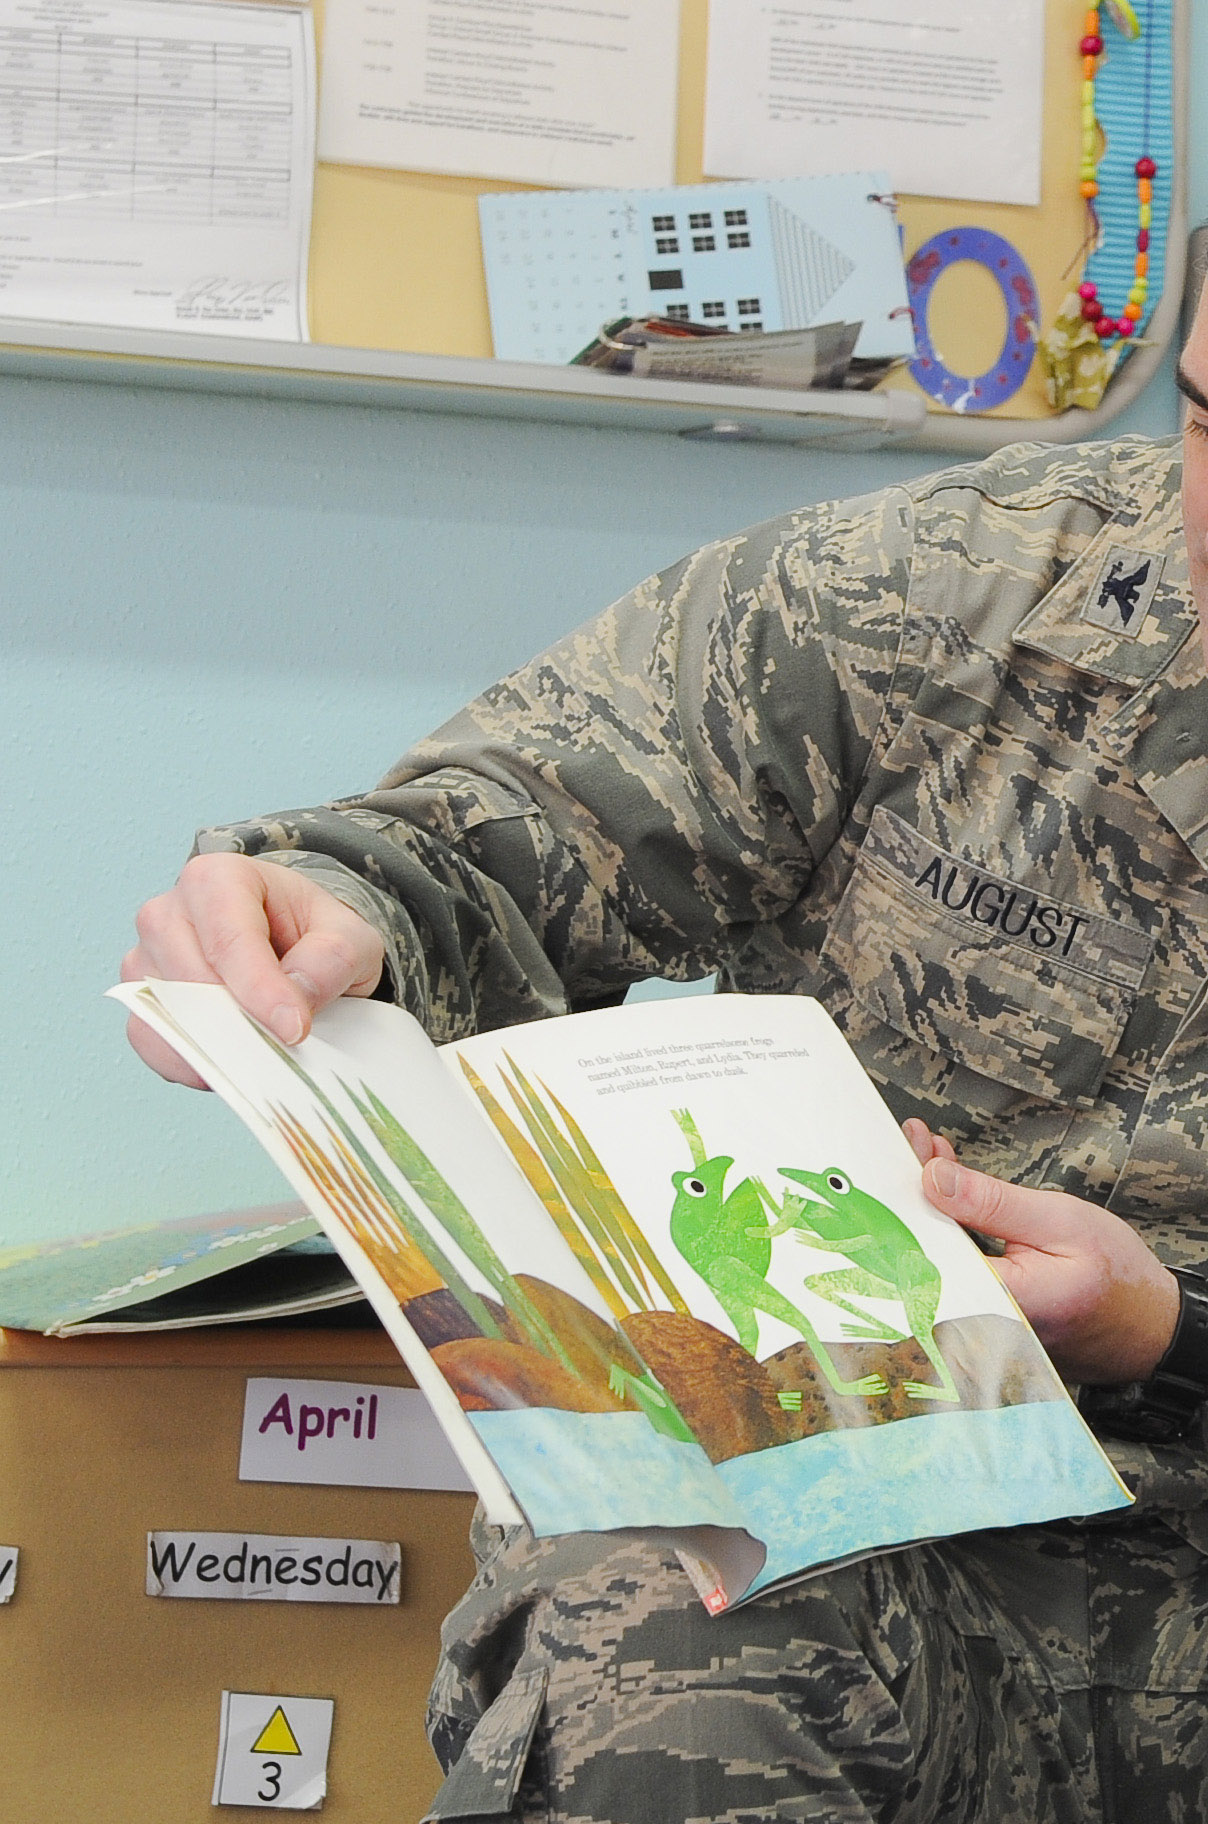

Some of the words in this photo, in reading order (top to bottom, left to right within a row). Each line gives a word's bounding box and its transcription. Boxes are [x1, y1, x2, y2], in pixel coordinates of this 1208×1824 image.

[915, 856, 1090, 957] AUGUST
[577, 1058, 595, 1068] On
[595, 1055, 612, 1065] the
[615, 1050, 643, 1062] island
[644, 1046, 667, 1057] lived
[668, 1043, 694, 1053] three
[750, 1036, 775, 1047] frogs
[588, 1068, 621, 1082] named
[657, 1058, 695, 1071] Rupert,
[696, 1054, 714, 1065] and
[743, 1050, 767, 1061] They
[596, 1083, 615, 1096] and
[659, 1075, 684, 1085] from
[685, 1071, 711, 1081] dawn
[711, 1069, 723, 1078] to
[259, 1392, 378, 1451] April
[150, 1540, 399, 1600] Wednesday
[257, 1761, 282, 1802] 3
